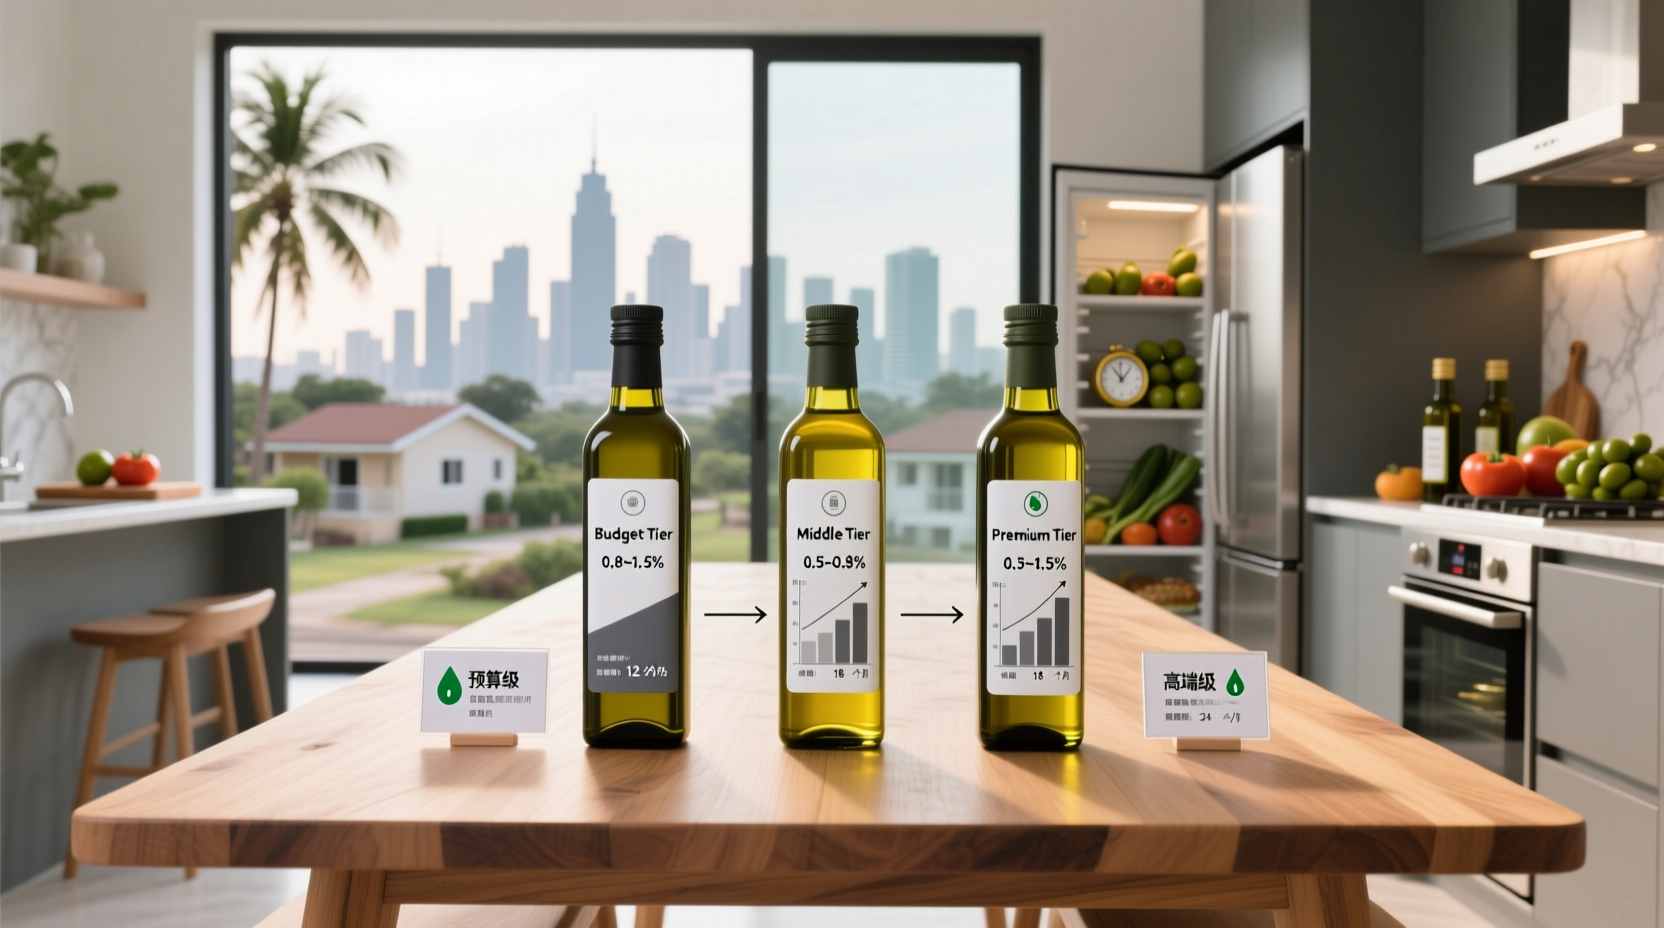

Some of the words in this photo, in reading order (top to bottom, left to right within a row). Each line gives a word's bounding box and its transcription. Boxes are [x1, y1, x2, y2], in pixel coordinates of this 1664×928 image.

[595, 527, 644, 544] Budget
[647, 527, 673, 540] Tier
[797, 526, 843, 540] Middle
[845, 527, 871, 540] Tier
[992, 528, 1050, 541] Premium
[1052, 528, 1077, 541] Tier
[626, 665, 640, 677] 12
[468, 670, 519, 689] 预算级
[1163, 671, 1216, 691] 高端级
